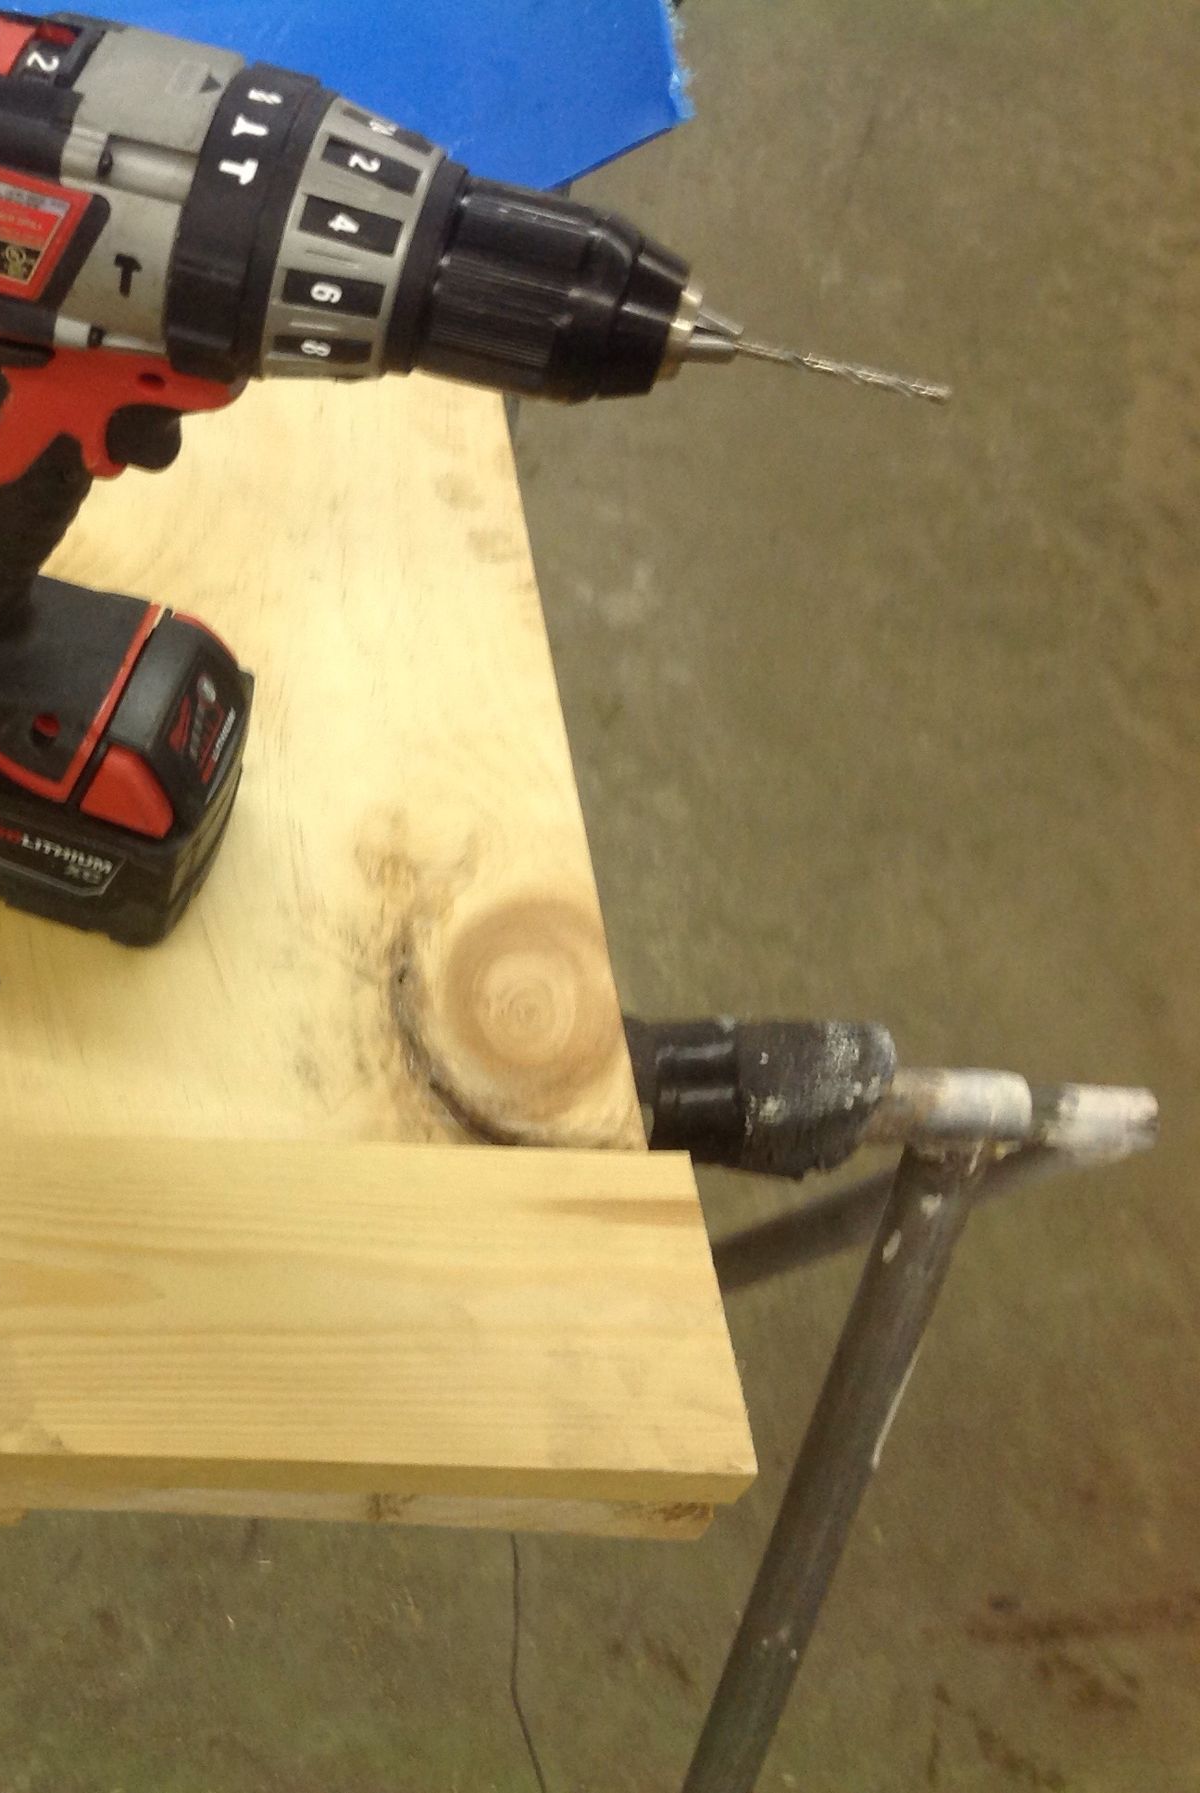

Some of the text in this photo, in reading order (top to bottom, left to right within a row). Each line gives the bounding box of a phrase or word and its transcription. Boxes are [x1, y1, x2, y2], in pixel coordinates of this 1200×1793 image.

[26, 51, 60, 73] 2
[348, 152, 381, 173] 2
[328, 212, 361, 234] 4
[310, 281, 343, 304] 6
[300, 338, 332, 358] 8
